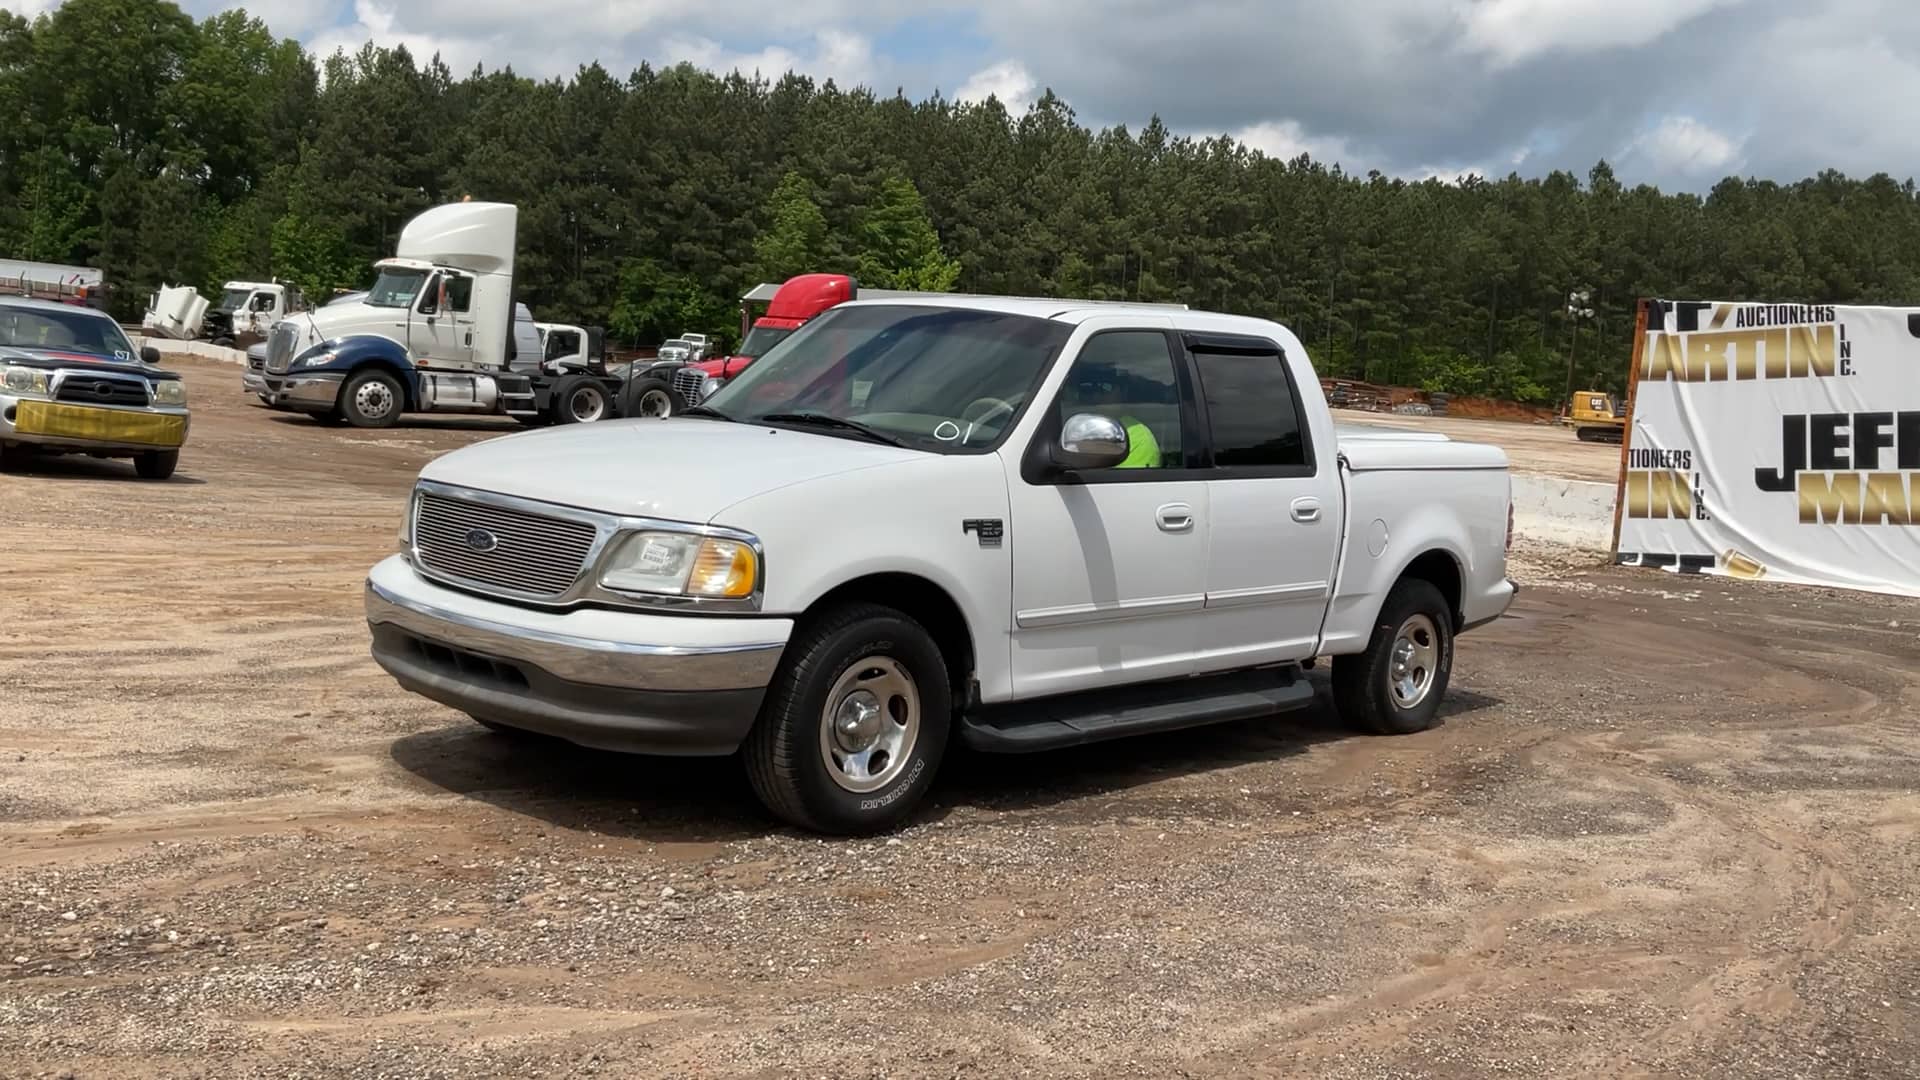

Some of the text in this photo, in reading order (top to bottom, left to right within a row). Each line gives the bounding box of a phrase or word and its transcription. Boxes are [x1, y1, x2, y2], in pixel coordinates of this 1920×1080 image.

[1735, 304, 1836, 329] AUCTIONEERS
[1637, 325, 1836, 383] ARTIN
[1799, 472, 1920, 525] MA
[861, 758, 925, 810] MICHELIN
